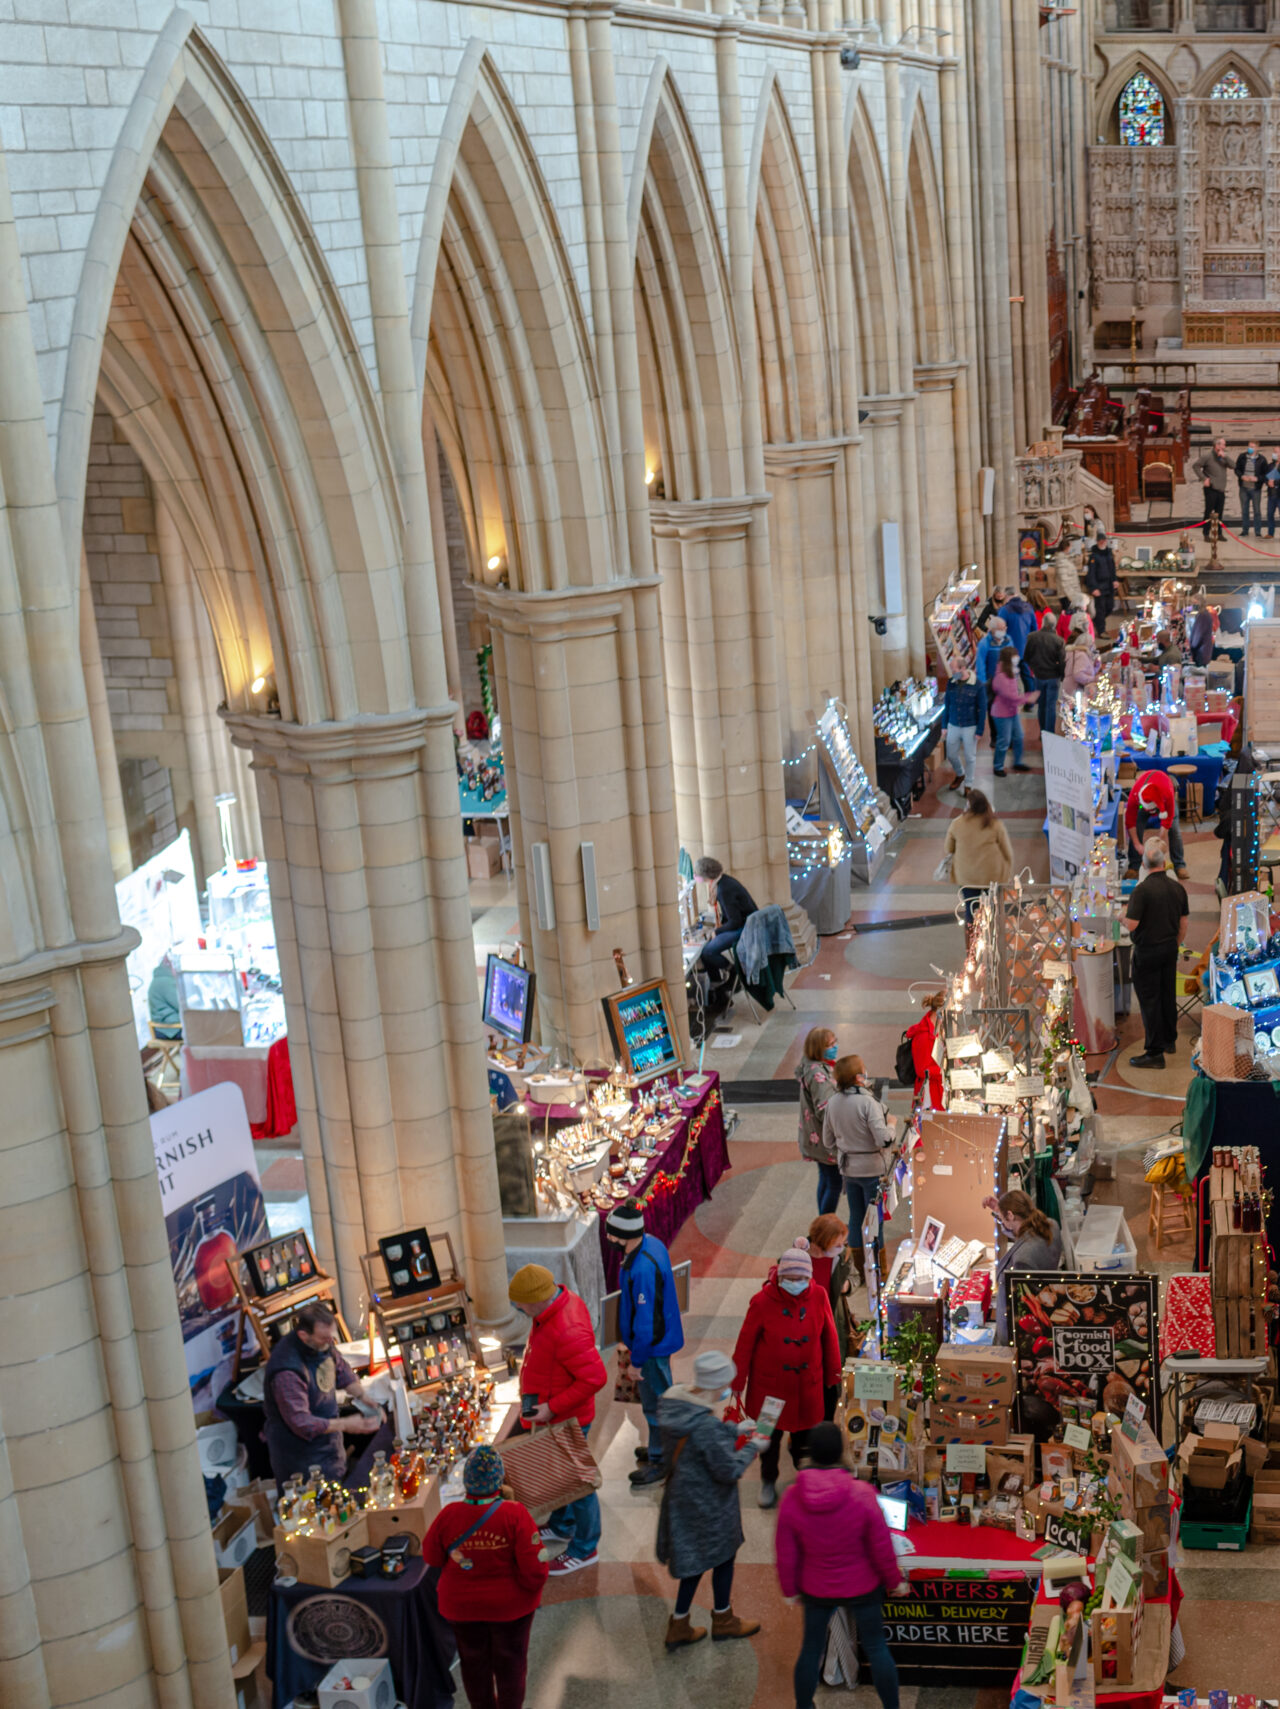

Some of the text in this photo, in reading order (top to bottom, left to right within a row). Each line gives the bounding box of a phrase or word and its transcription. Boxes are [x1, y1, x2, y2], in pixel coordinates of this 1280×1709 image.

[1047, 761, 1087, 783] Imagine
[1056, 1330, 1111, 1347] Cornish
[1073, 1339, 1111, 1353] food
[1057, 1347, 1114, 1368] box
[1045, 1515, 1082, 1553] Local
[888, 1582, 998, 1599] AMPERS
[941, 1605, 1008, 1620] DELIVERY
[882, 1625, 951, 1642] ORDER
[957, 1625, 1010, 1643] HERE
